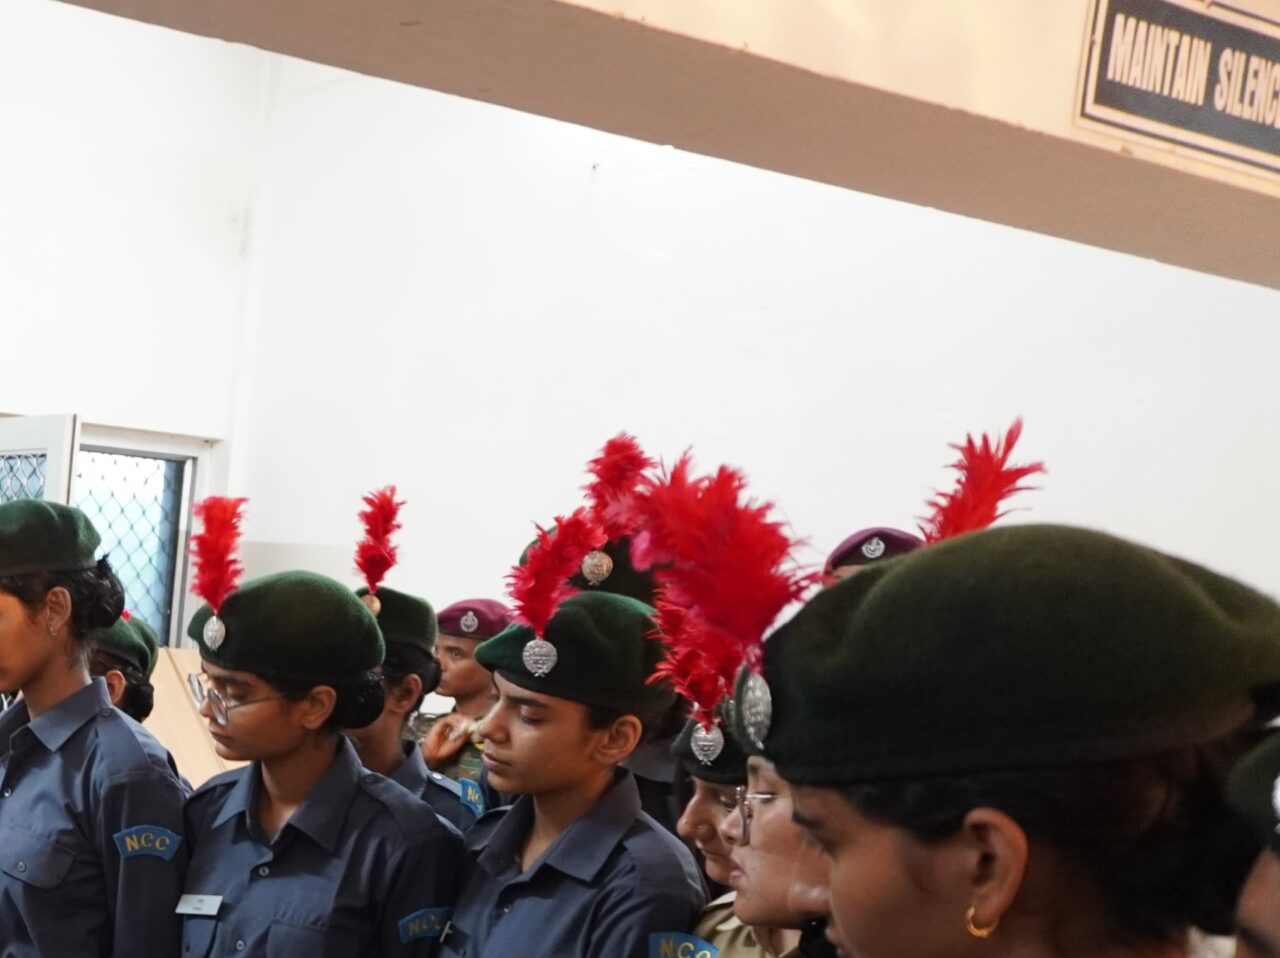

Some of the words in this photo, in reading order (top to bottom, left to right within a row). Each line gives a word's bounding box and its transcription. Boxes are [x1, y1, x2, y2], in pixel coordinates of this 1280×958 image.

[1106, 13, 1212, 107] MAINTAIN
[1214, 47, 1280, 130] SILENC
[124, 832, 171, 852] NCC
